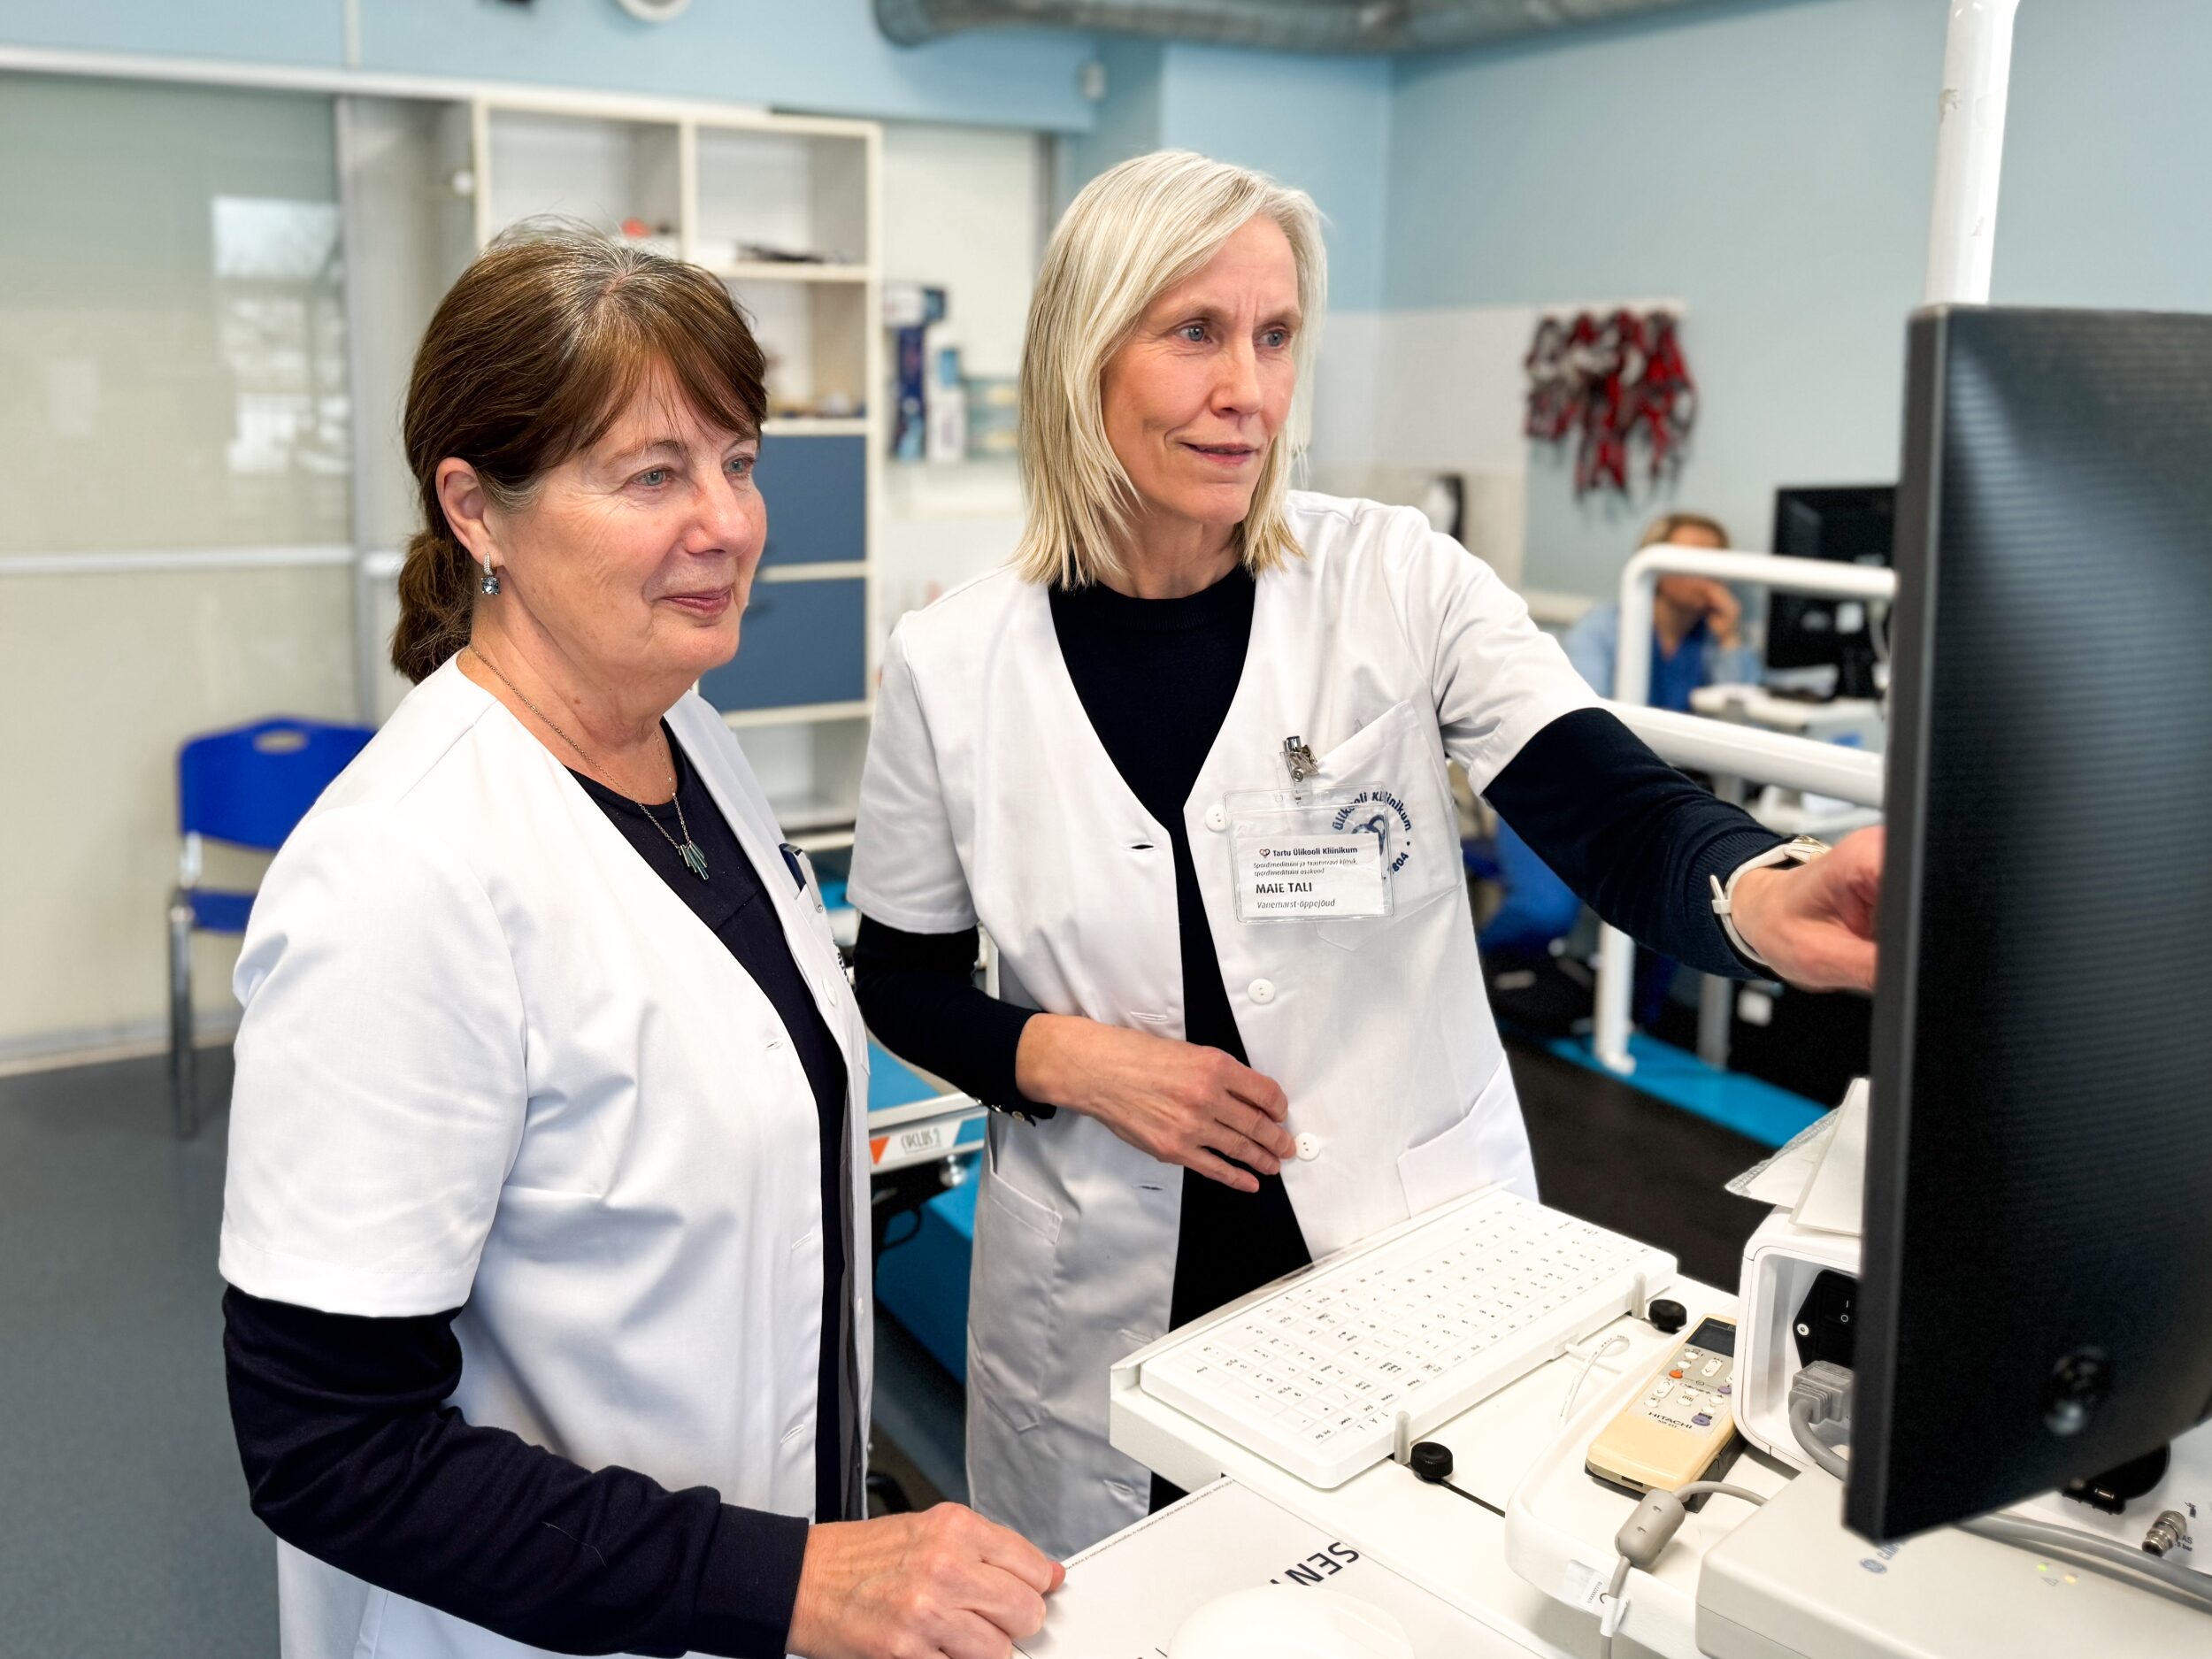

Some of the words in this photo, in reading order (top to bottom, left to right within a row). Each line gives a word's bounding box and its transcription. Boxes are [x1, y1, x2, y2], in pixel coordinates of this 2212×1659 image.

[1293, 848, 1320, 856] Ülikooli
[1386, 852, 1409, 874] 804
[1256, 883, 1285, 894] MAIE
[1288, 882, 1312, 893] TALI
[1648, 1411, 1693, 1429] HITACHI
[1270, 1541, 1360, 1586] SEN
